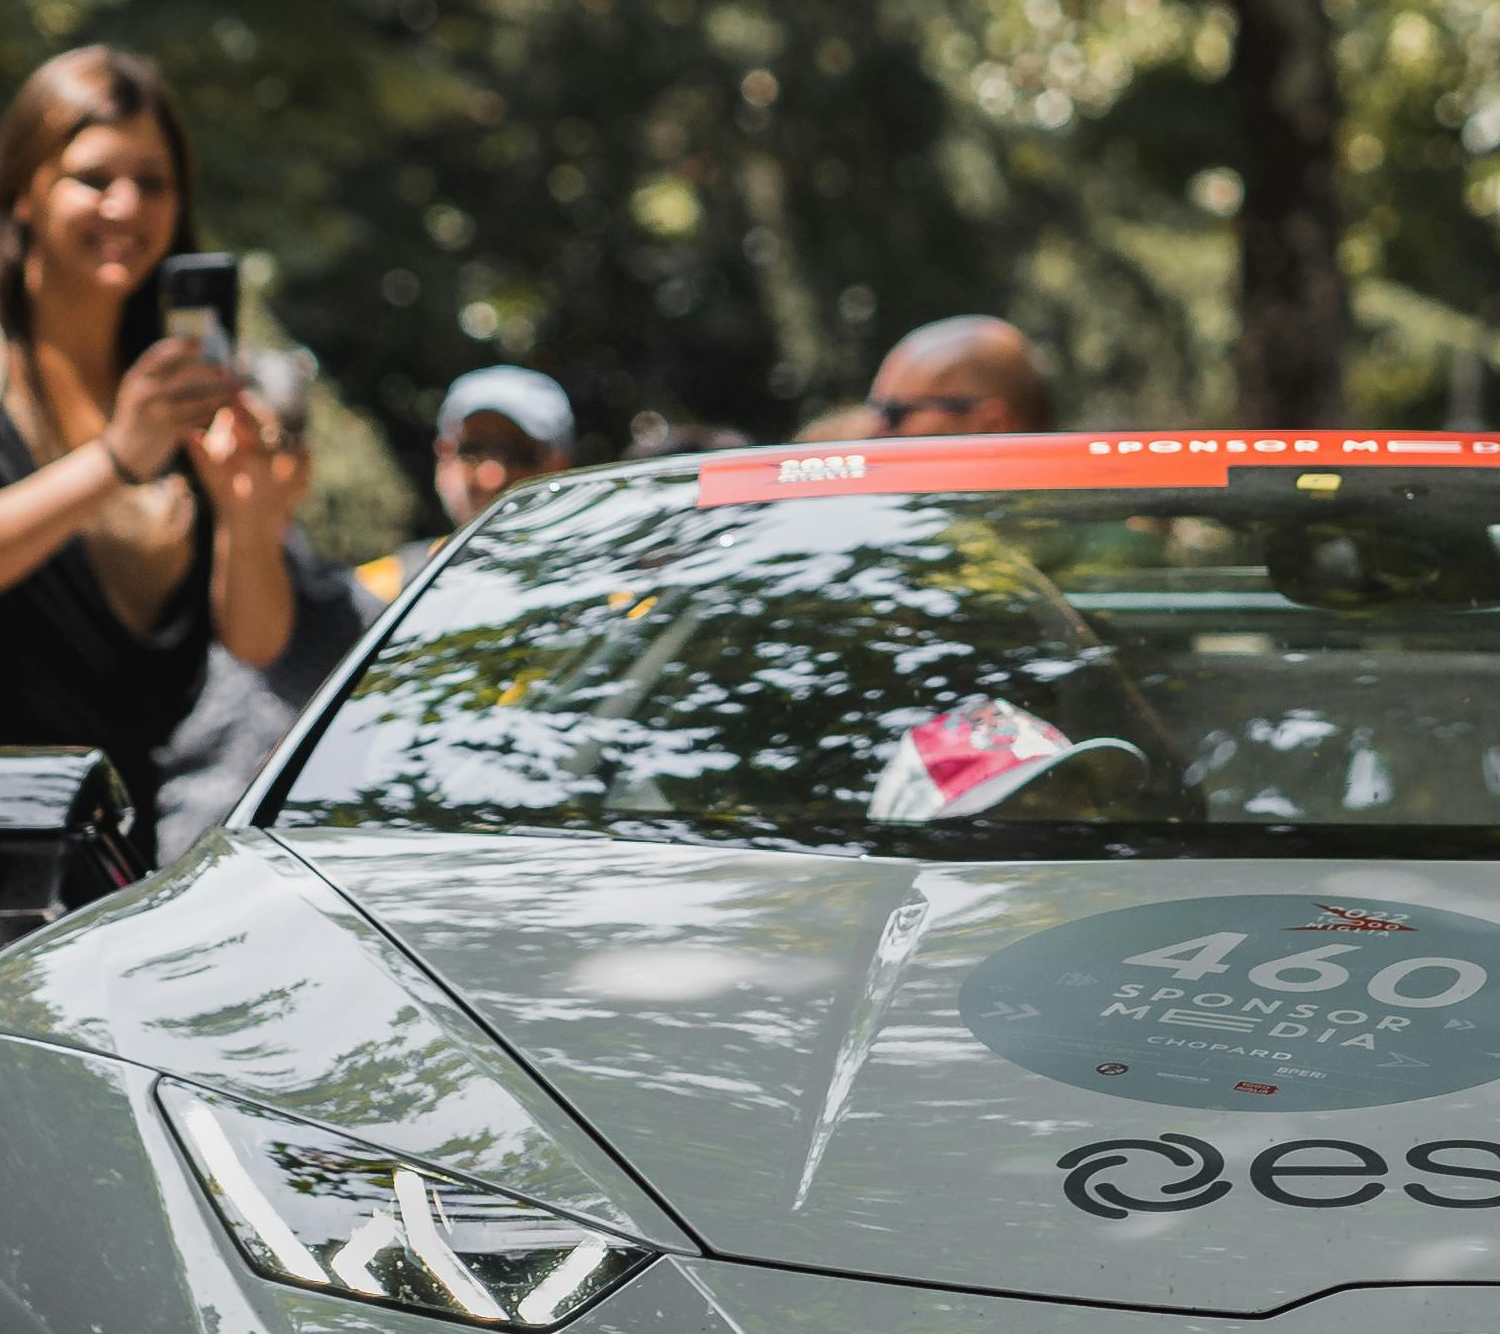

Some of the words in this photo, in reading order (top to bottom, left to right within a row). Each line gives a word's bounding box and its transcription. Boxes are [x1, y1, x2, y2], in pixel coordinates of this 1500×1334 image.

[1088, 438, 1321, 455] SPONSOR
[1320, 905, 1410, 925] 2022
[1121, 932, 1489, 1009] 460
[1100, 1001, 1377, 1051] MEDIA
[1112, 983, 1412, 1033] SPONSOR
[1147, 1034, 1293, 1061] CHOPARD
